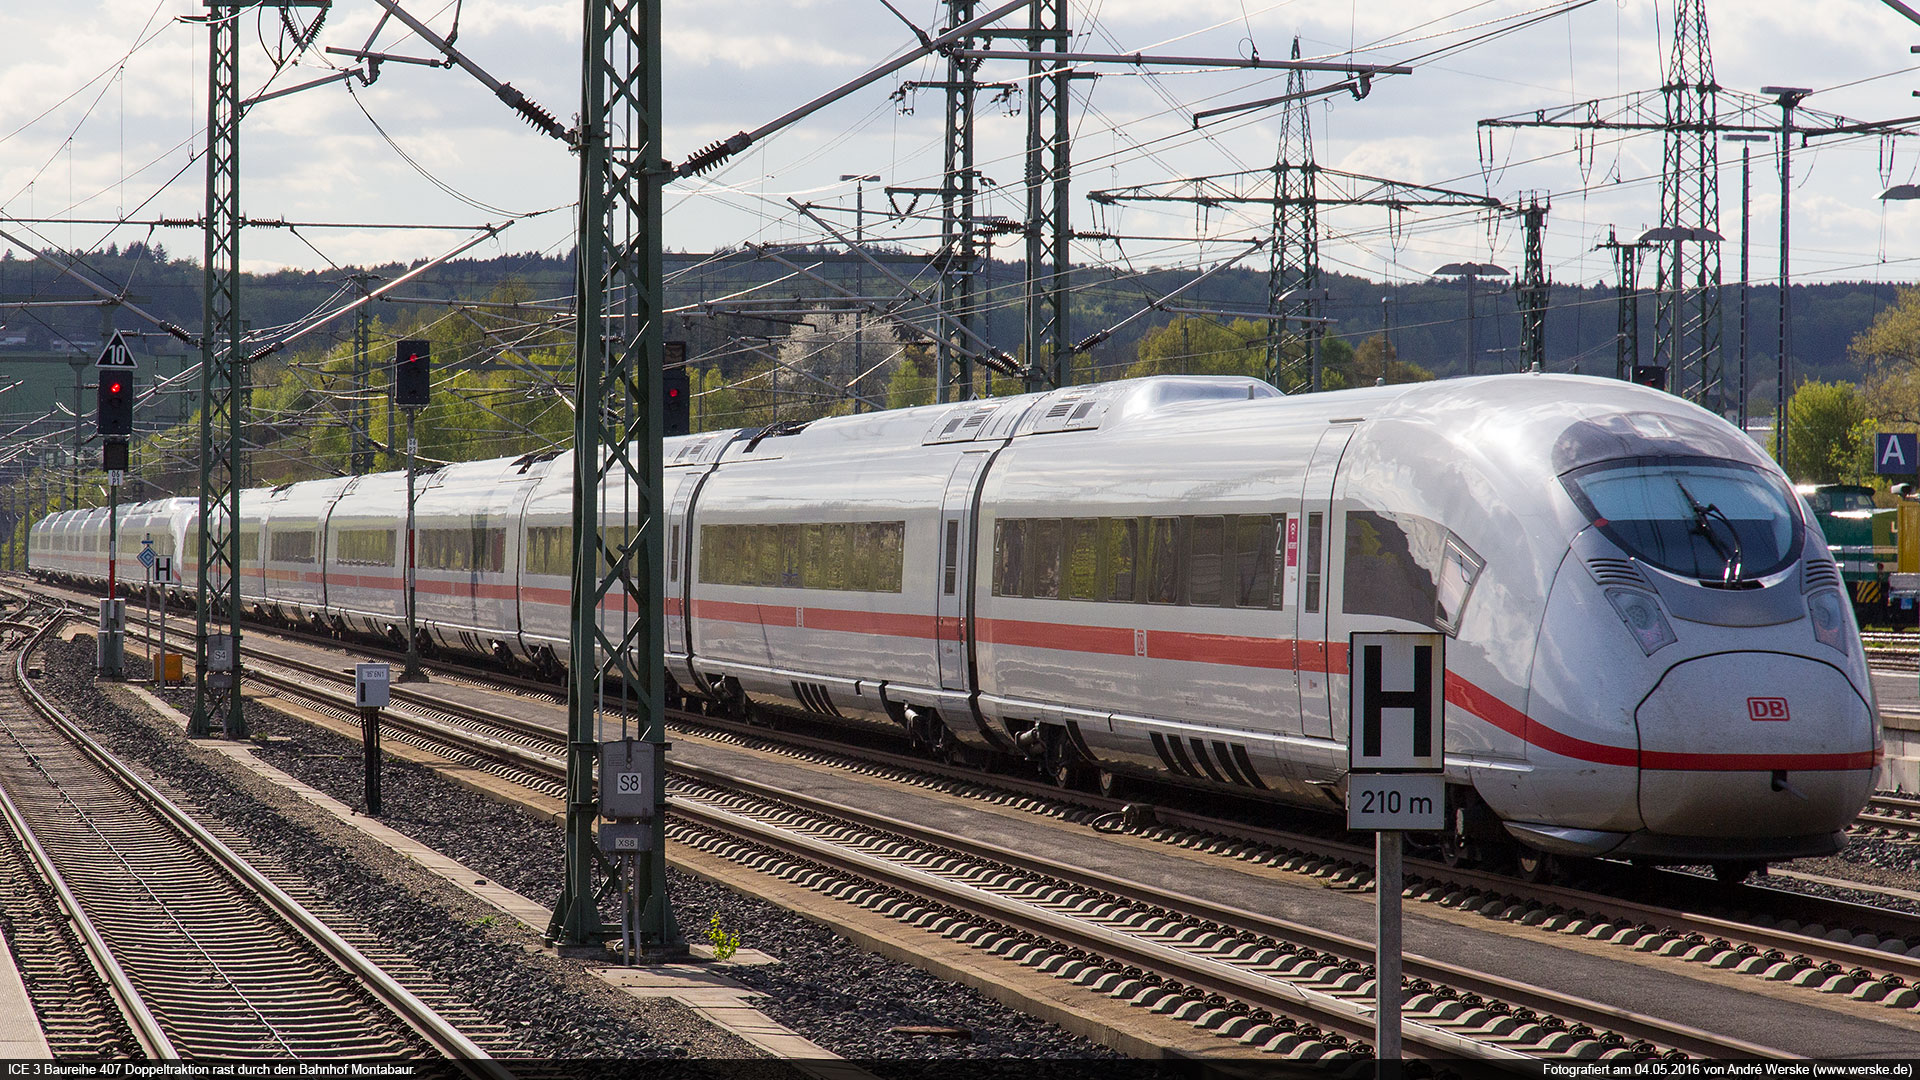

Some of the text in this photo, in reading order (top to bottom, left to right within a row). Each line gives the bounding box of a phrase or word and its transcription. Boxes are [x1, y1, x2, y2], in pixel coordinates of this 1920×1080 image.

[109, 345, 126, 365] 10
[1881, 435, 1906, 465] A
[1276, 522, 1282, 555] 2
[156, 558, 170, 580] H
[214, 651, 226, 660] S4
[1363, 645, 1433, 757] H
[1751, 700, 1786, 718] DB
[620, 775, 639, 791] S8
[1361, 790, 1433, 814] 210 m
[618, 839, 635, 848] XS8
